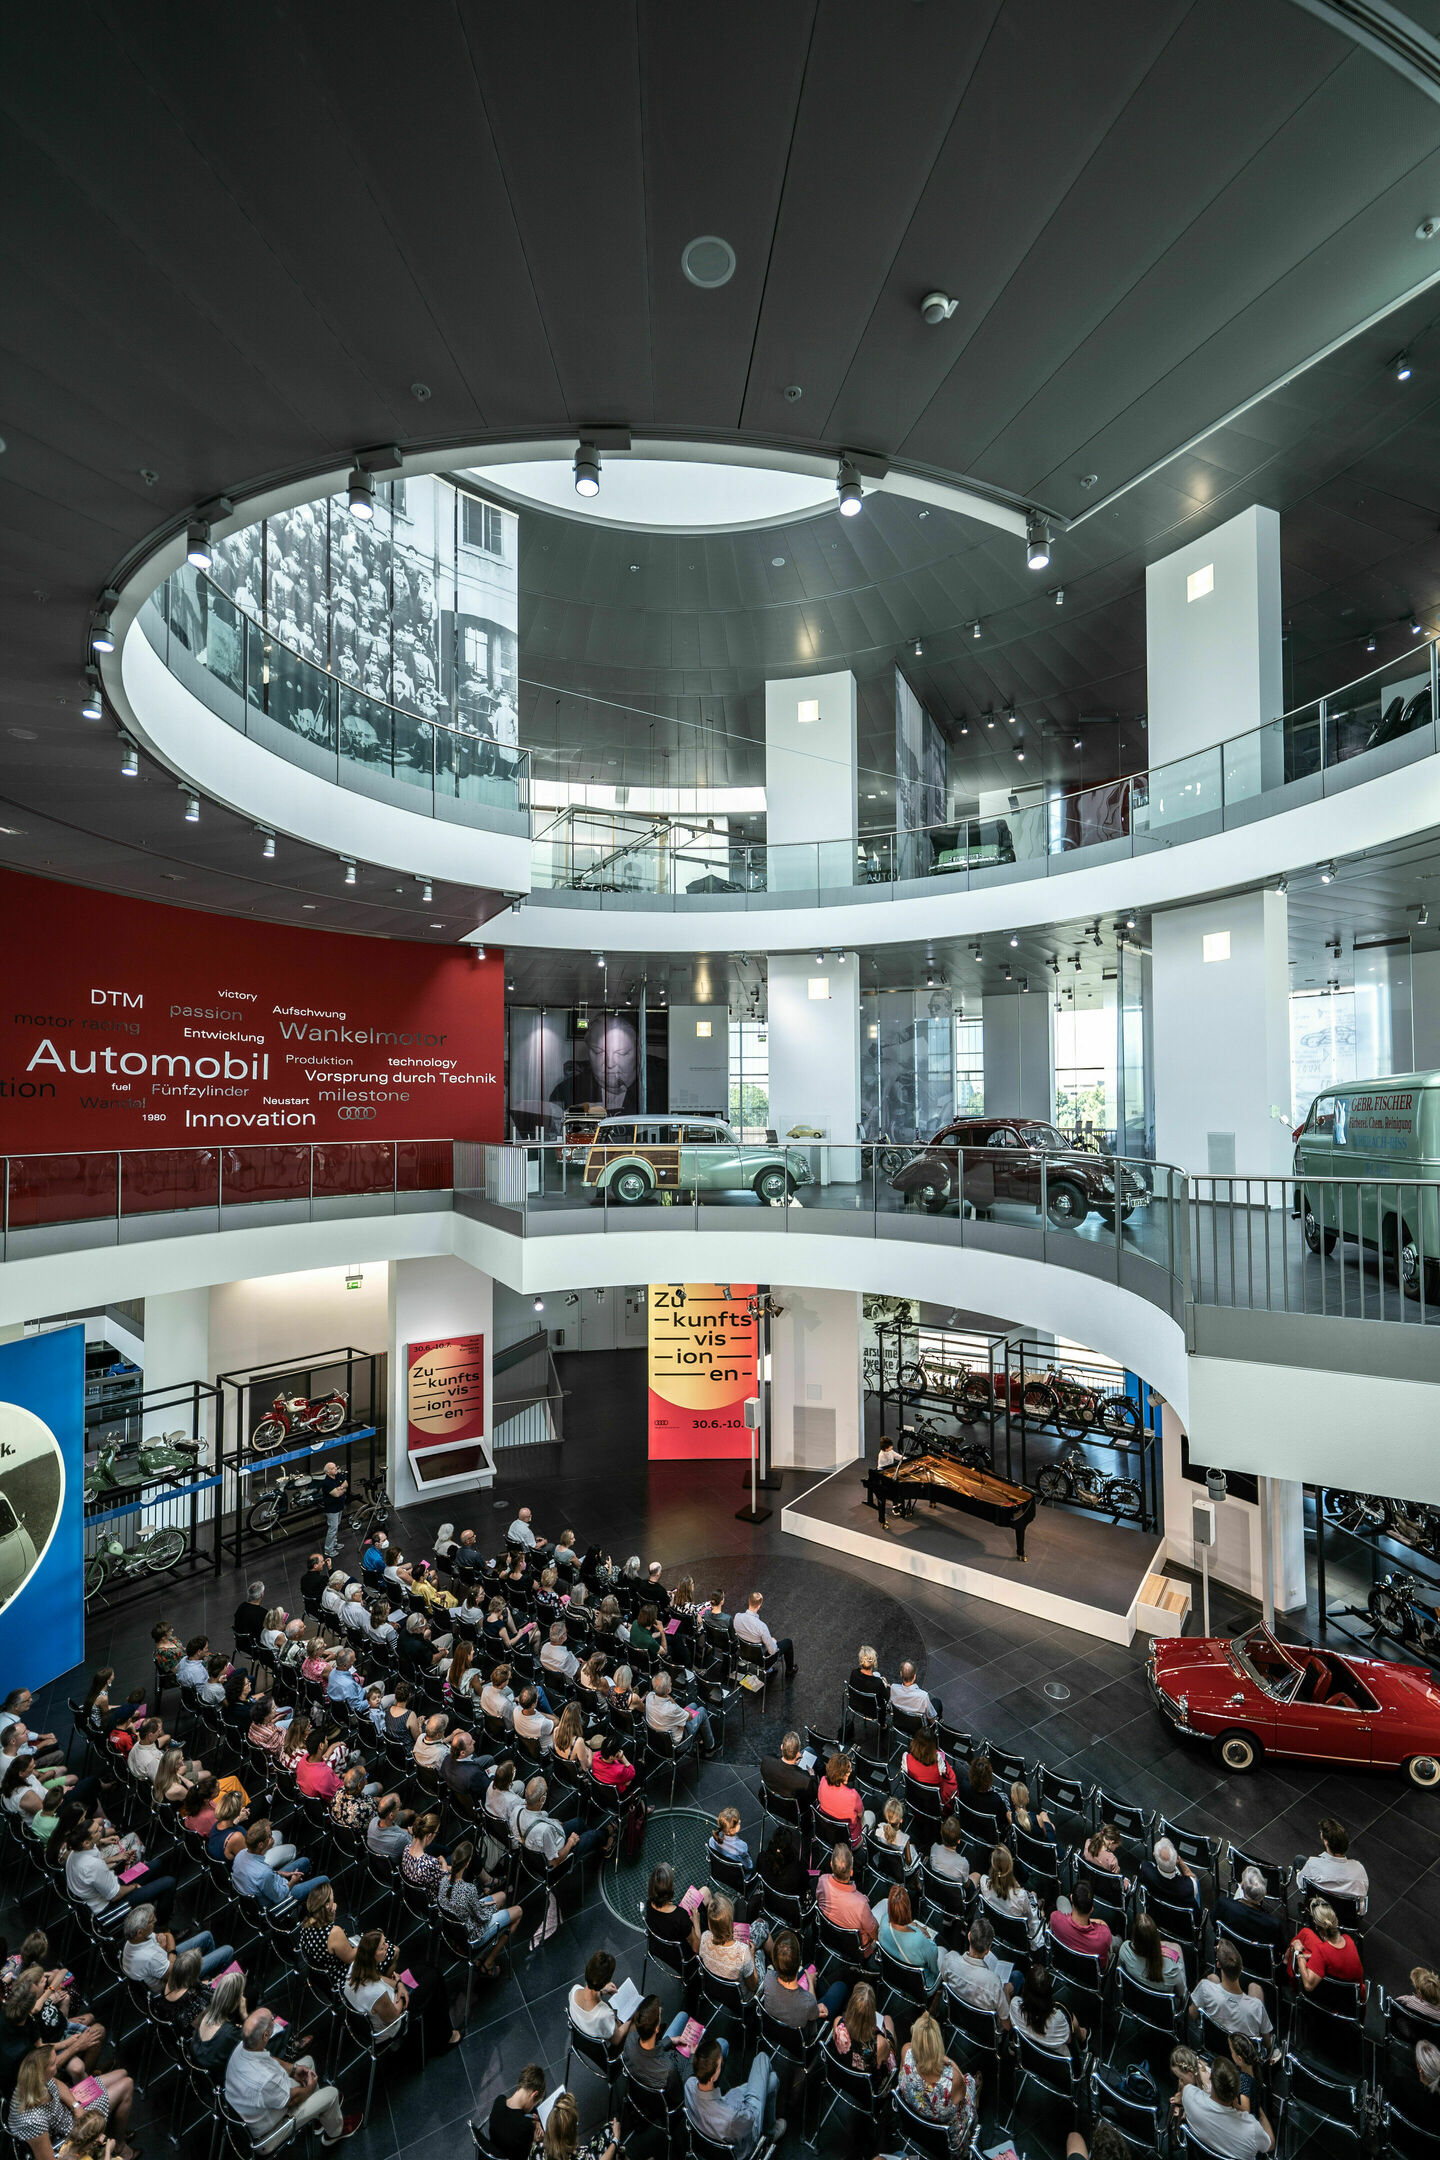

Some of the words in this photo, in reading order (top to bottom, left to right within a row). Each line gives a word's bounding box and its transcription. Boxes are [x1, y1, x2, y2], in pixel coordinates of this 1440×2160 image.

[91, 988, 144, 1008] DTM
[218, 989, 258, 1002] victory
[170, 1003, 243, 1022] passion
[272, 1005, 346, 1021] Aufschwung
[13, 1013, 74, 1028] motor
[81, 1018, 141, 1036] racing
[184, 1027, 265, 1045] Entwicklung
[279, 1021, 447, 1047] Wankelmotor
[26, 1039, 269, 1081] Automobil
[286, 1054, 354, 1067] Produktion
[388, 1057, 457, 1069] technology
[305, 1069, 389, 1085] Vorsprung
[392, 1071, 436, 1084] durch
[439, 1072, 497, 1085] Technik
[111, 1082, 131, 1091] fuel
[152, 1083, 250, 1099] Fünfzylinder
[79, 1096, 146, 1109] Wandel
[263, 1096, 310, 1105] Neustart
[318, 1088, 411, 1102] milestone
[1351, 1096, 1374, 1112] GEBR.
[1374, 1094, 1413, 1111] FISCHER
[142, 1113, 167, 1122] 1980
[185, 1109, 316, 1127] Innovation
[654, 1292, 684, 1308] Zu
[673, 1311, 752, 1327] kunfts
[694, 1331, 727, 1346] vis
[413, 1342, 452, 1353] 30.6.-10.7.
[676, 1348, 713, 1364] ion
[413, 1367, 434, 1379] Zu
[428, 1372, 480, 1389] kunfts
[709, 1369, 738, 1381] en
[447, 1385, 469, 1396] vis
[427, 1400, 451, 1411] ion
[444, 1408, 463, 1419] en
[692, 1420, 744, 1429] 30.6.-10.
